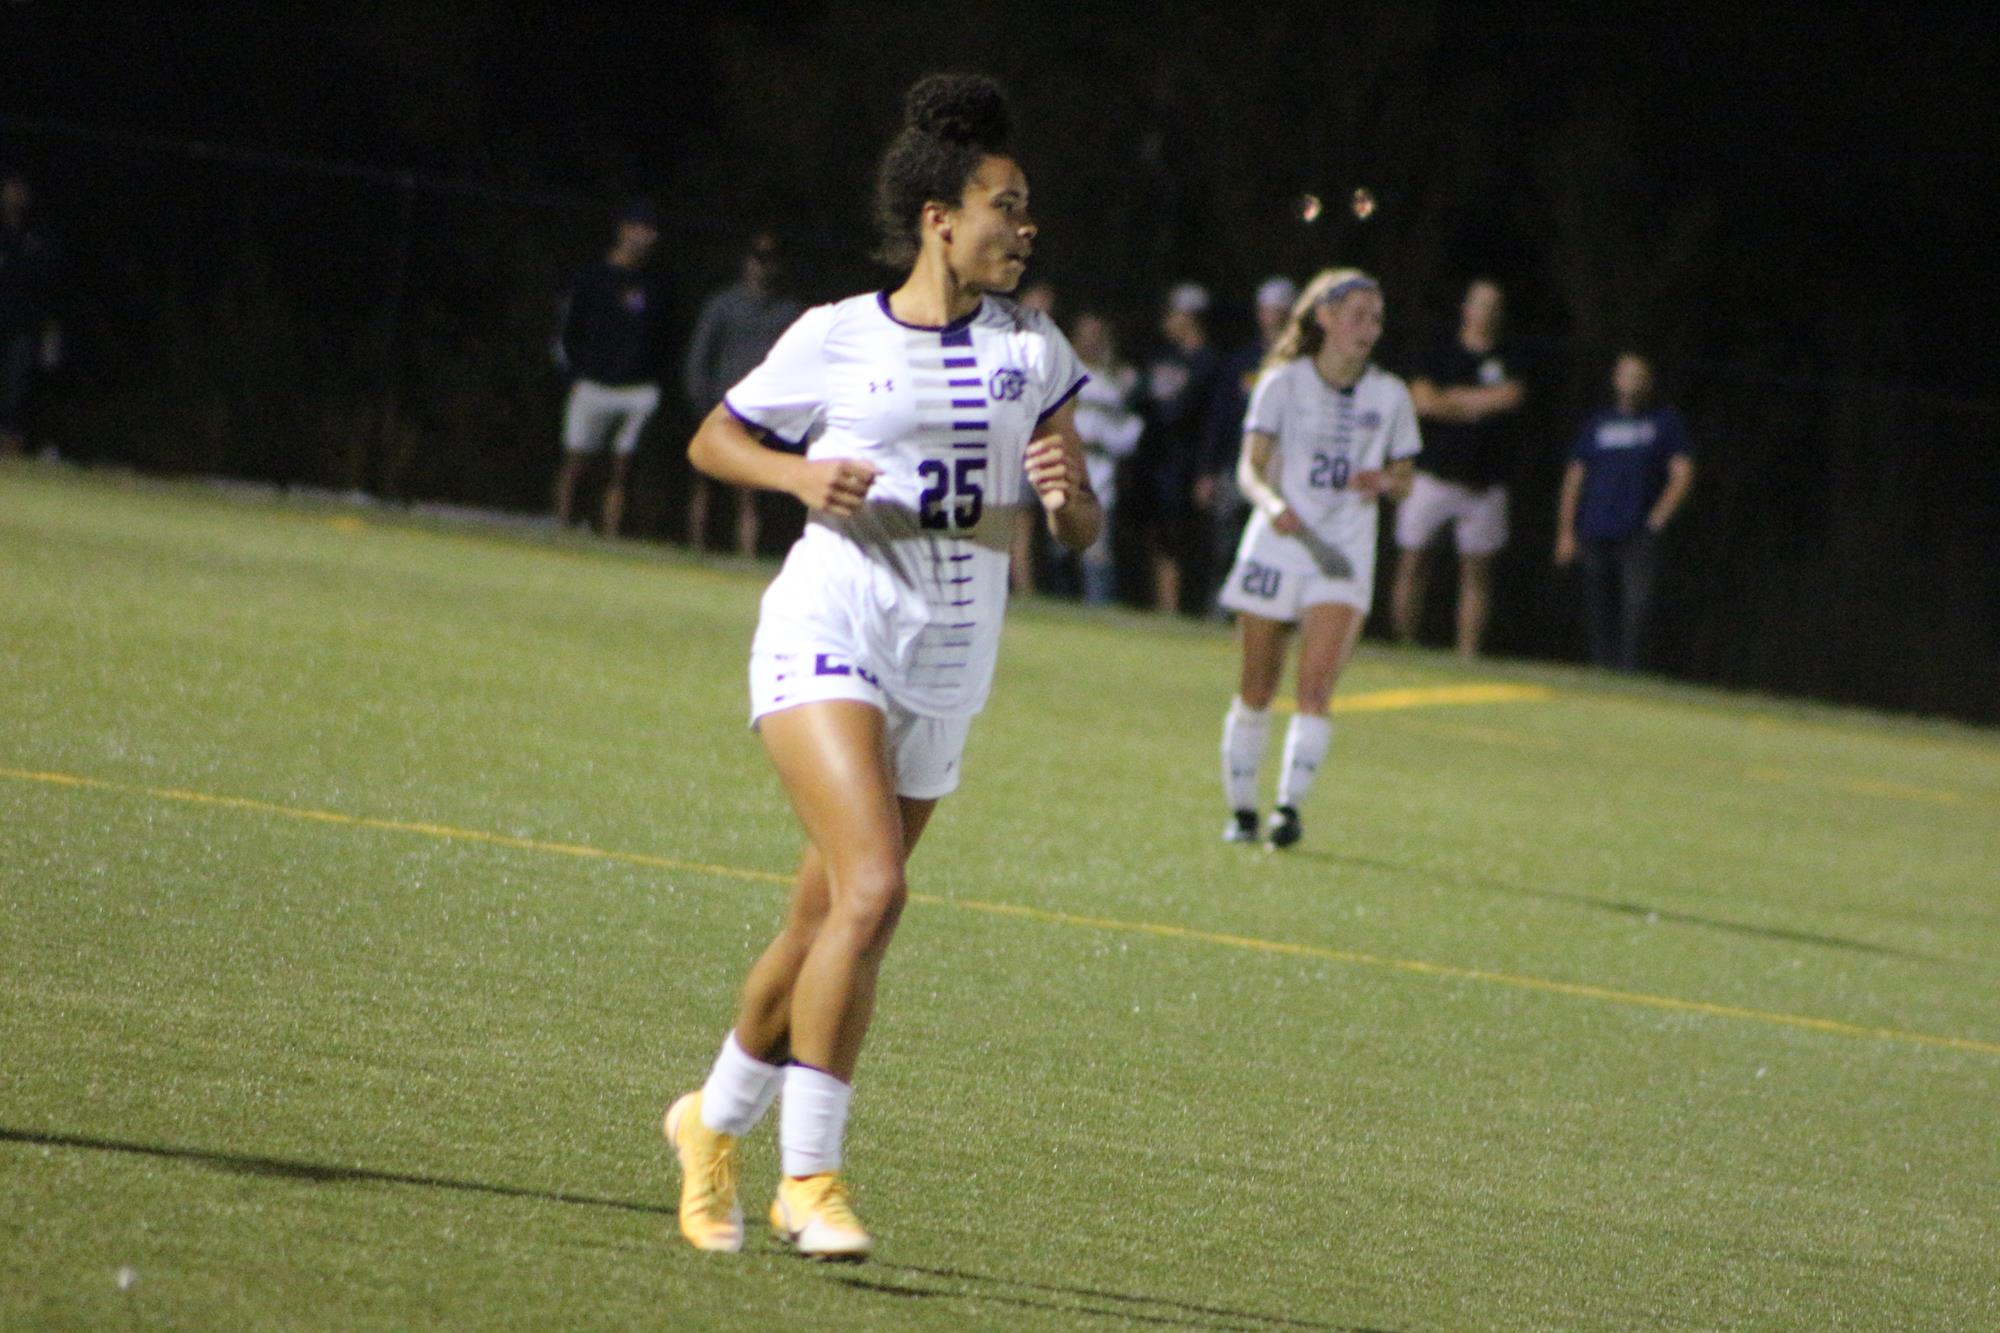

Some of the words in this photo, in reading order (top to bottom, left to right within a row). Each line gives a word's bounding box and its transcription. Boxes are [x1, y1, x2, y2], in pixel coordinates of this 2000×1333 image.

[1310, 452, 1349, 490] 20
[918, 458, 987, 528] 25
[1243, 561, 1282, 599] 20
